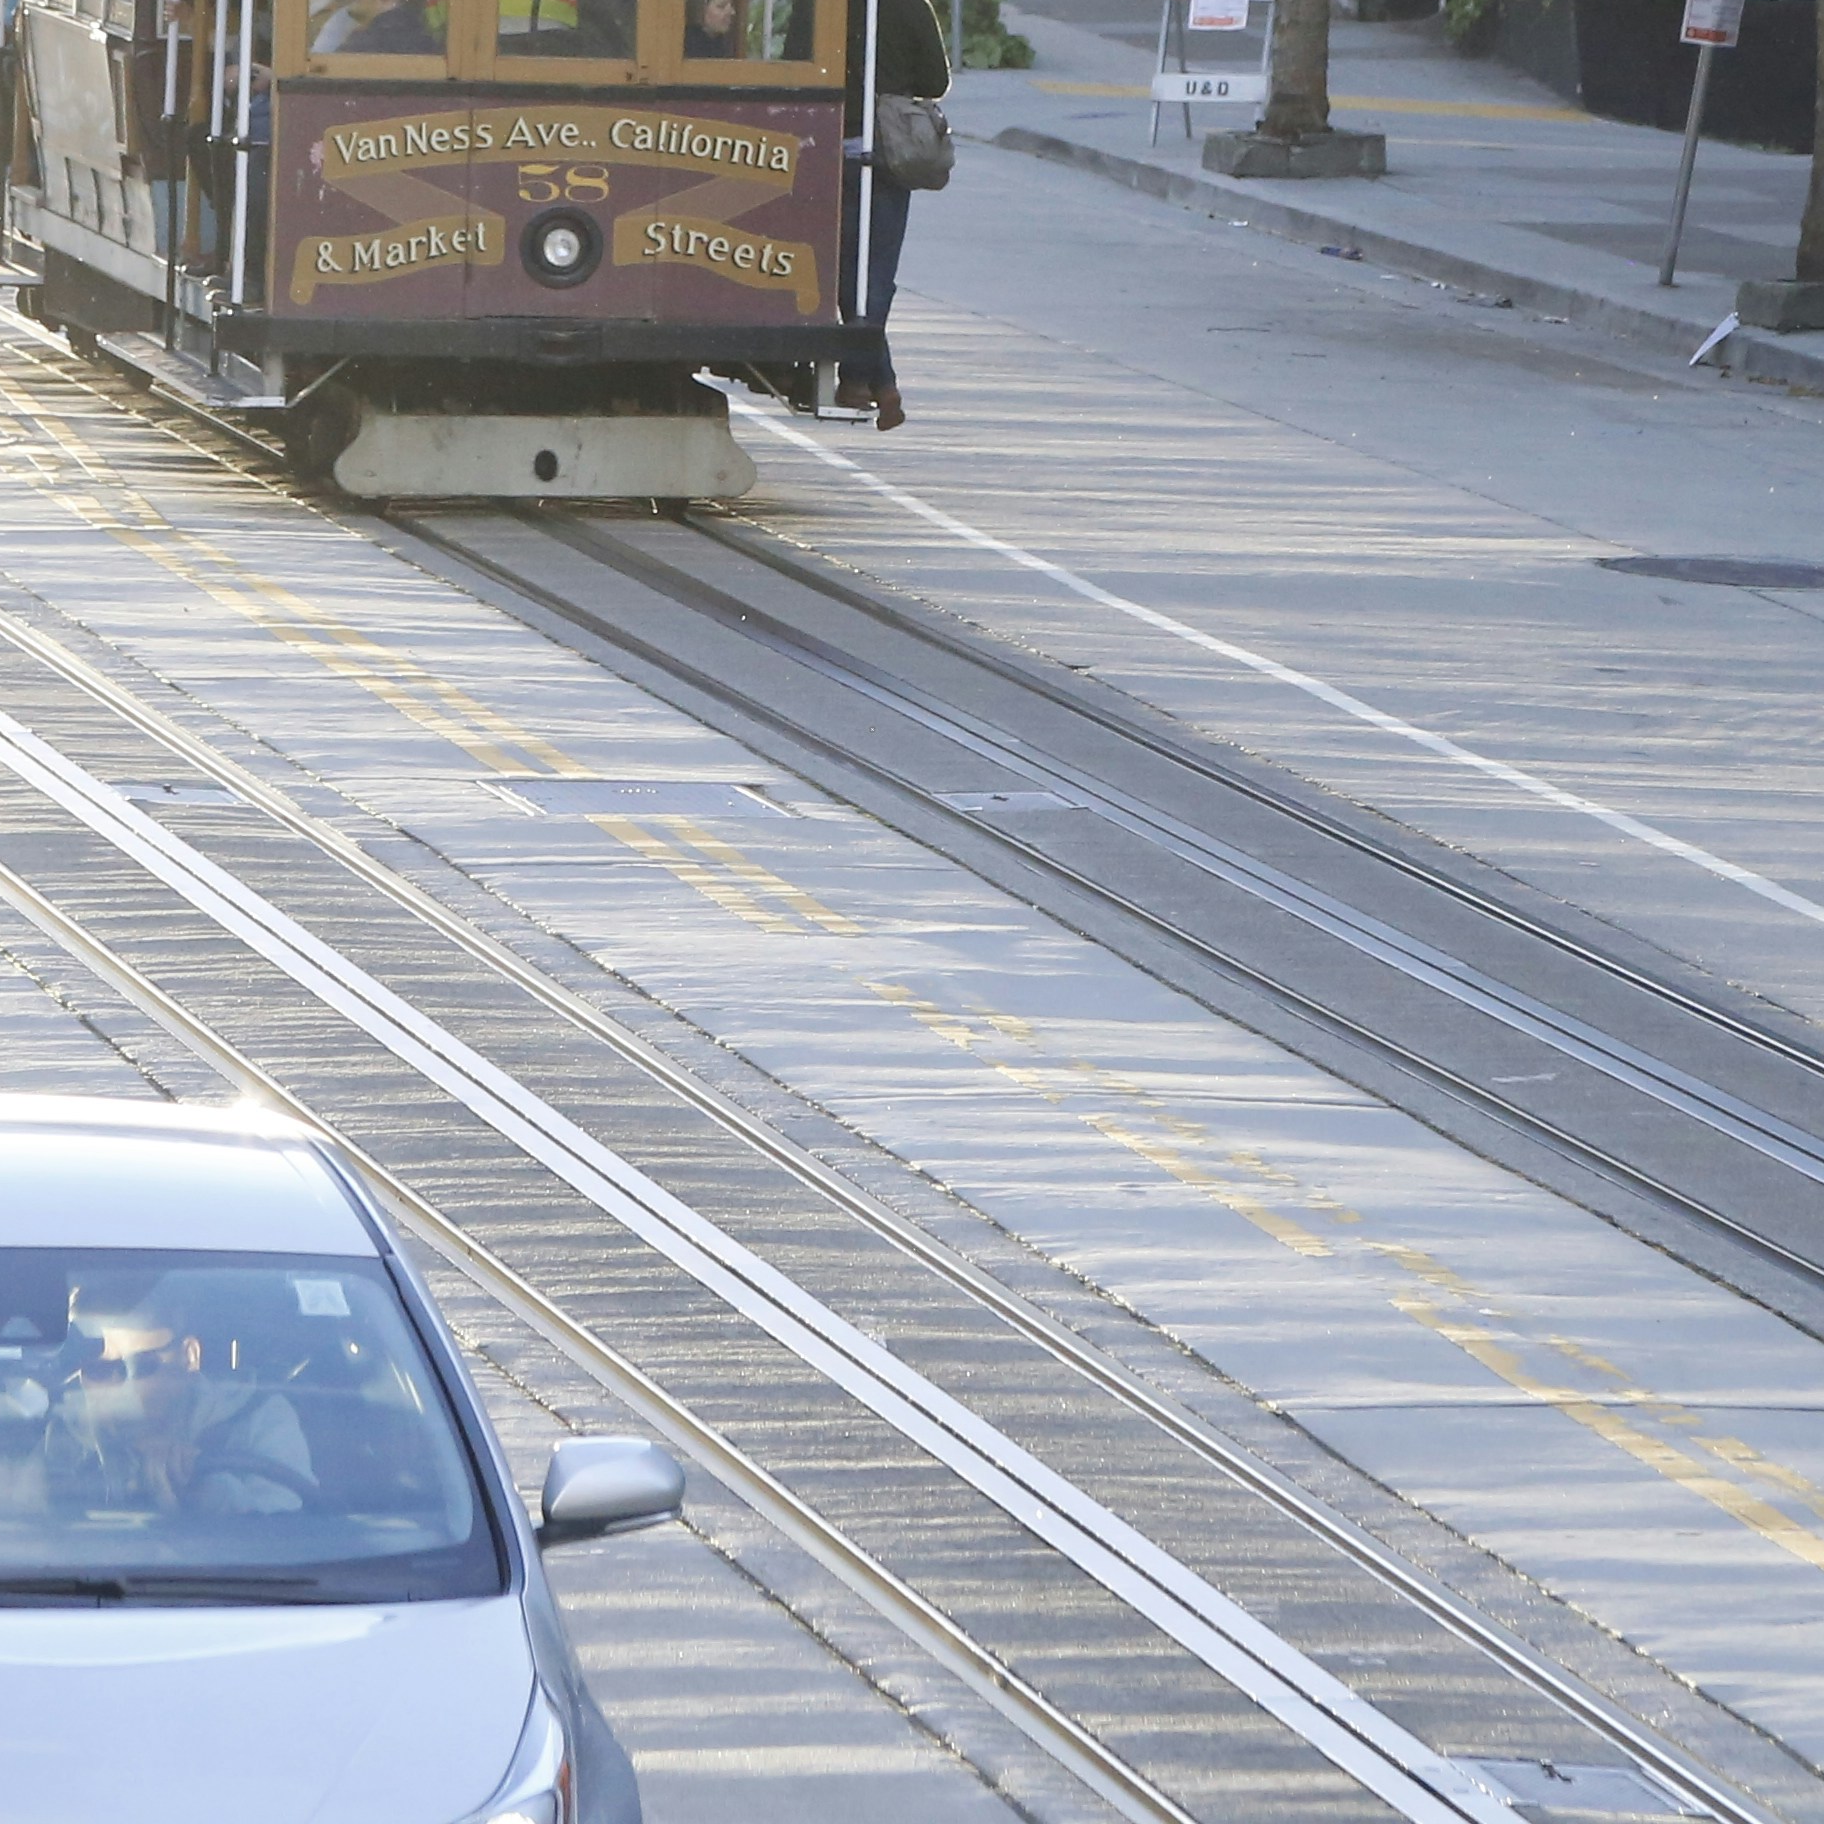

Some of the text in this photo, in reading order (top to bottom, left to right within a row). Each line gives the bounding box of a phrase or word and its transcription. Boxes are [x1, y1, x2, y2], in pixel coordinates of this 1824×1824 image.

[1185, 82, 1197, 96] U
[1201, 82, 1212, 95] &
[333, 131, 398, 165] Van
[405, 118, 493, 155] Ness
[611, 117, 791, 172] California
[517, 164, 610, 204] 58
[317, 221, 795, 277] & Market Streets
